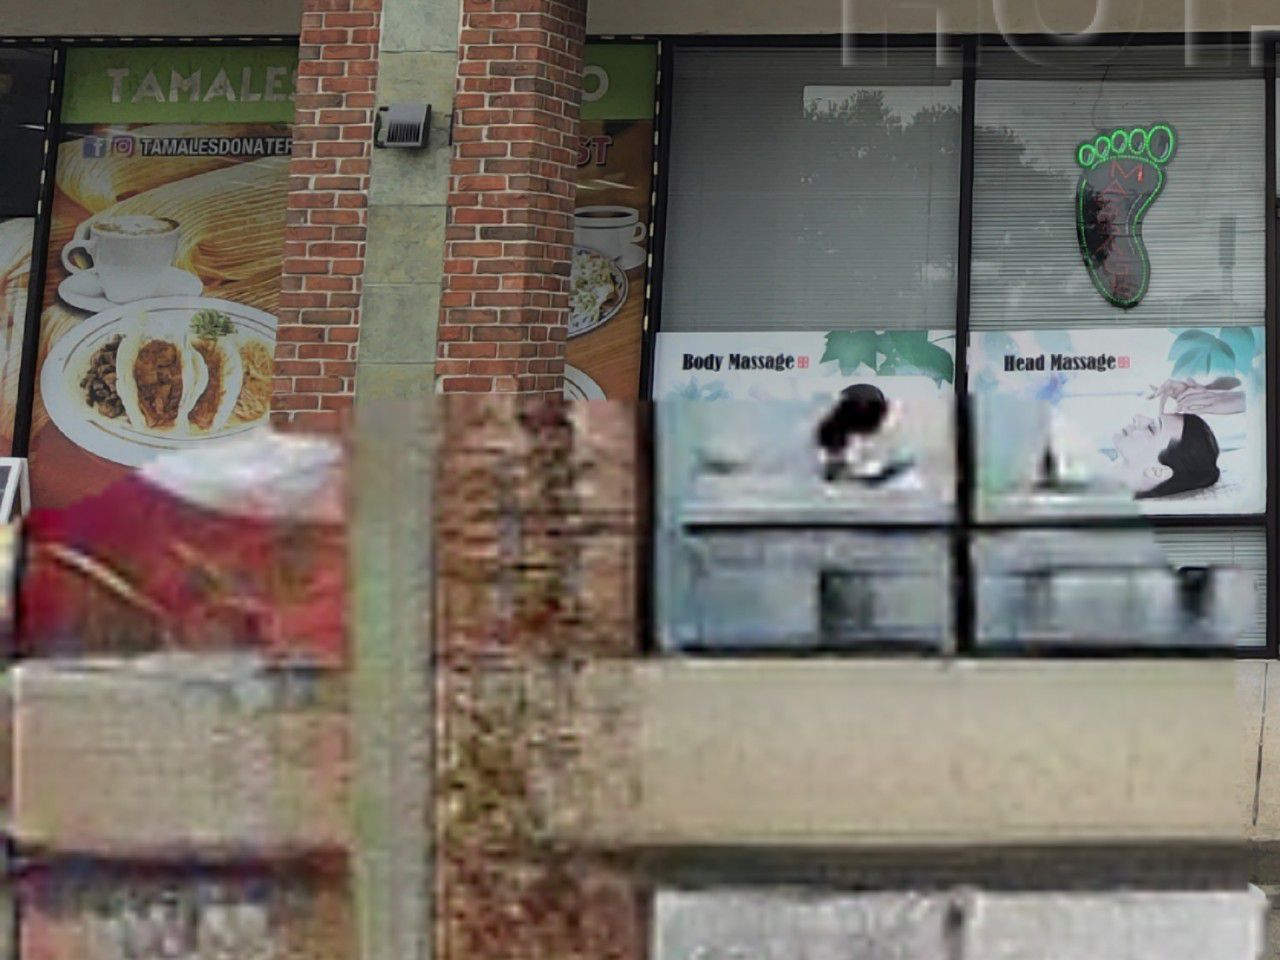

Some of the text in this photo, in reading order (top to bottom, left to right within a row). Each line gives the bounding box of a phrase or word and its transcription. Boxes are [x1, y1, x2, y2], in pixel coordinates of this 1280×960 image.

[105, 66, 297, 104] TAMALE
[682, 353, 723, 372] Body
[728, 353, 796, 372] Massage
[1004, 354, 1046, 371] Head
[1050, 353, 1117, 372] Massage
